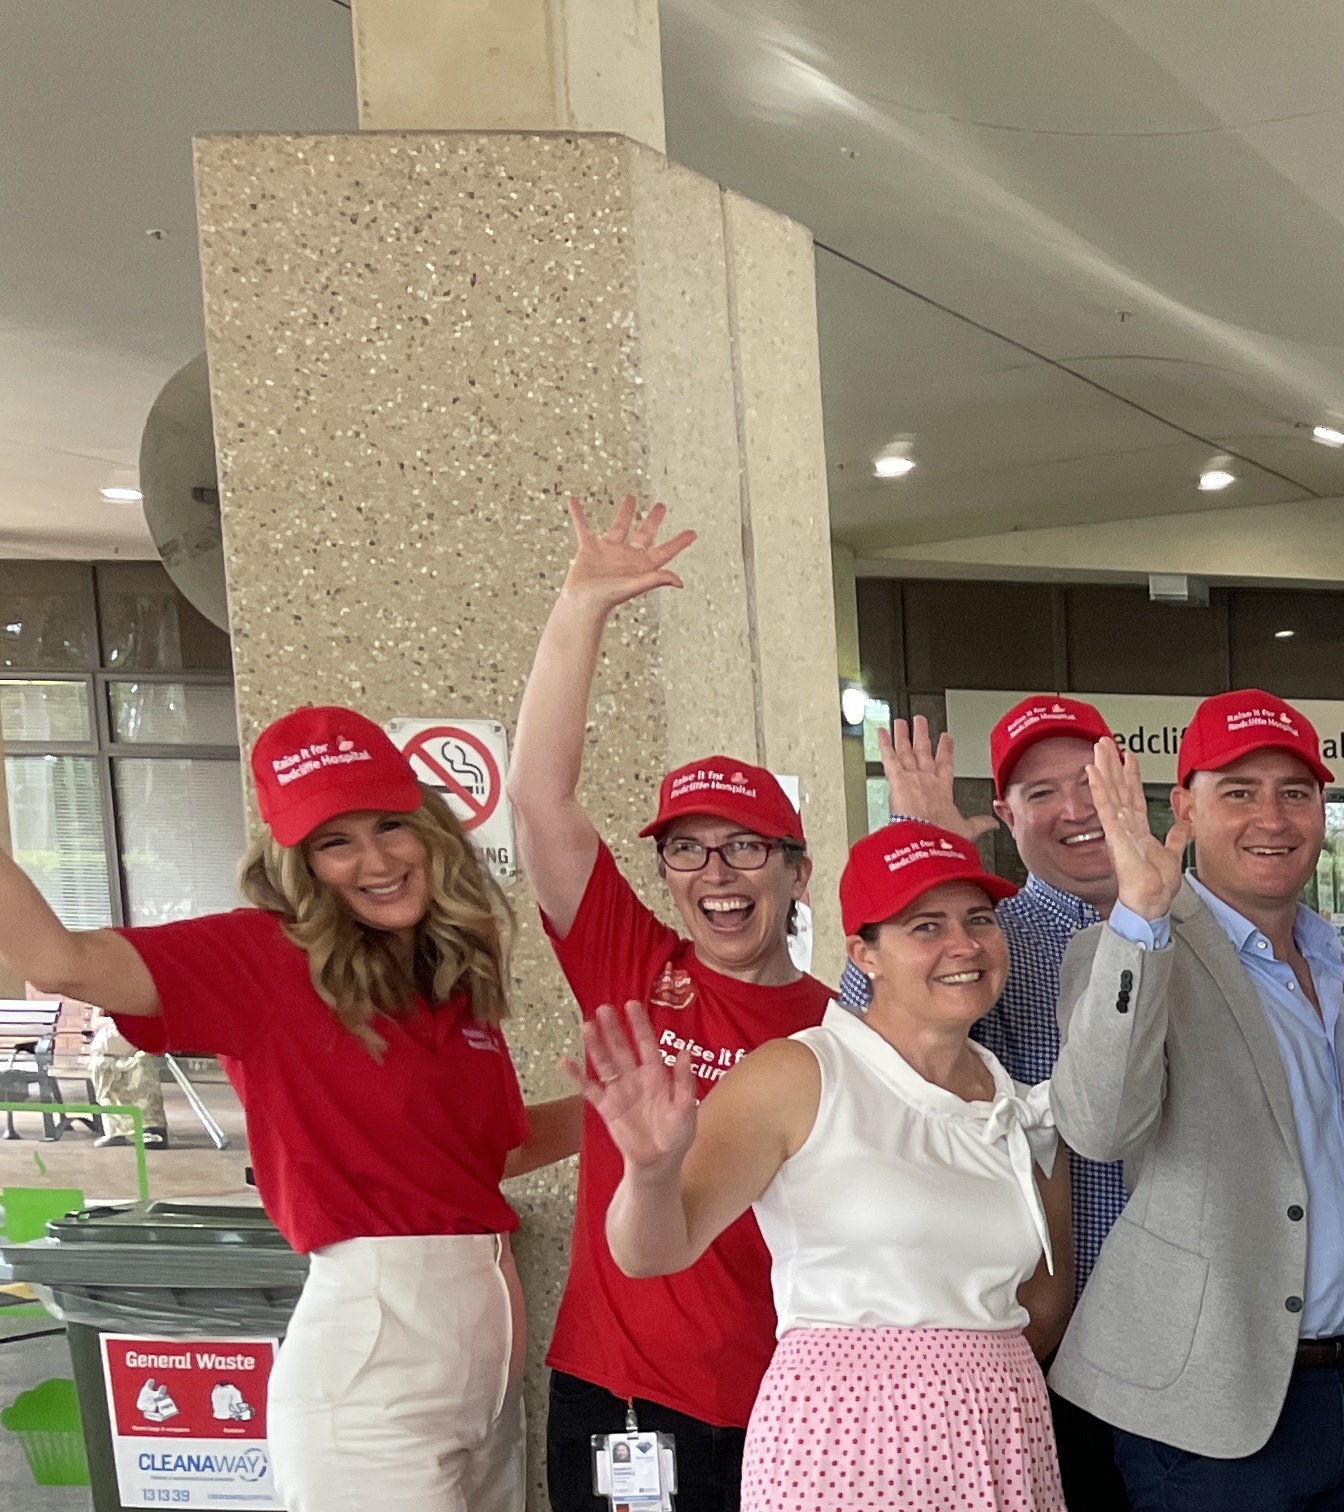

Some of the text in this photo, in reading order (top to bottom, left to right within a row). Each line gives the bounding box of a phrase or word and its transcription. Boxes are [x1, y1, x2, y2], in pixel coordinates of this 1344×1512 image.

[1112, 726, 1187, 755] edcli
[660, 1029, 715, 1062] Raise
[718, 1048, 732, 1067] it
[125, 1351, 256, 1371] General Waste
[138, 1453, 260, 1473] CLEANAWAY
